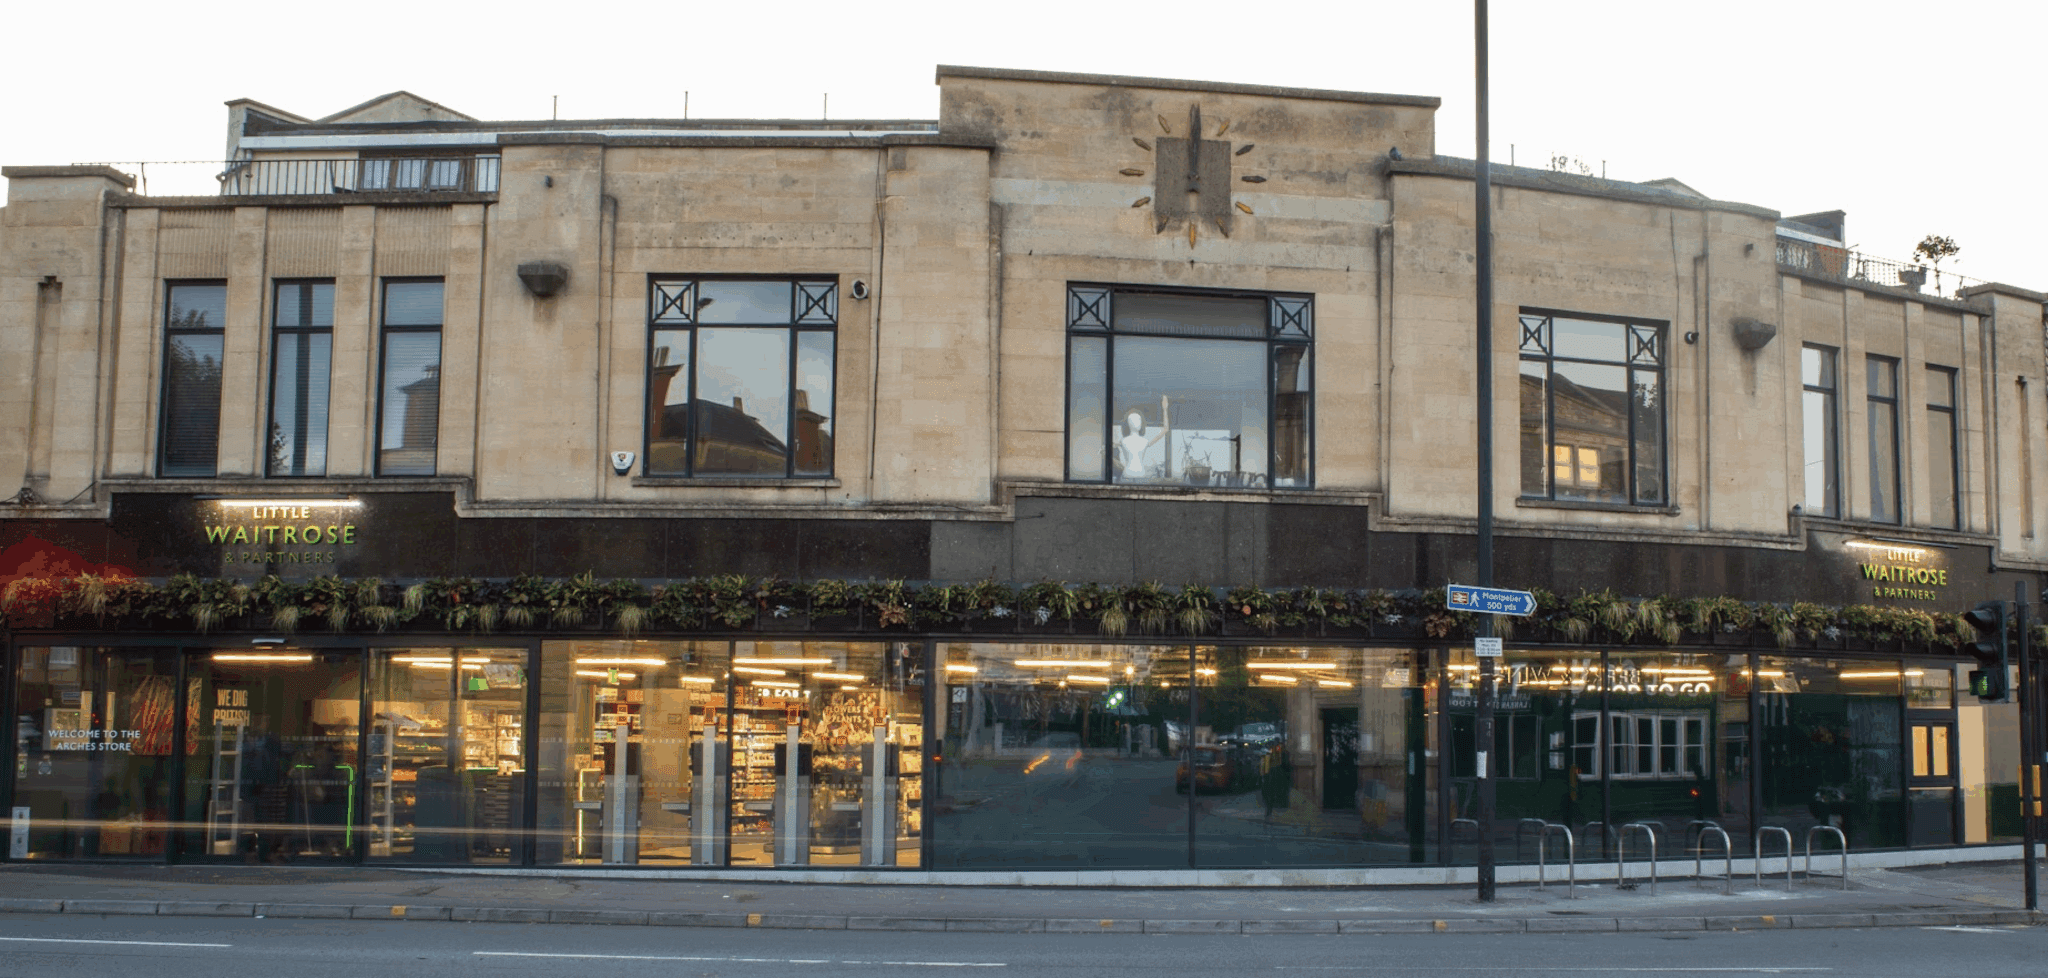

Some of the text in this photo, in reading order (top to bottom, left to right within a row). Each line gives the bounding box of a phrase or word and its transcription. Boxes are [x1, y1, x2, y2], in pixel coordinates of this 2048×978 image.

[253, 507, 310, 518] LITTLE
[205, 525, 356, 544] WAITROSE
[225, 552, 336, 563] & PARTNERS
[1887, 549, 1920, 562] LITTLE
[1863, 563, 1947, 586] WAITROSE
[1482, 592, 1522, 602] Montpelier
[1875, 586, 1936, 600] & PARTNERS
[1504, 602, 1517, 611] yds
[217, 689, 248, 706] WE DIG
[48, 729, 141, 739] WELCOME TO THE
[56, 742, 131, 751] ARCHES STORE
